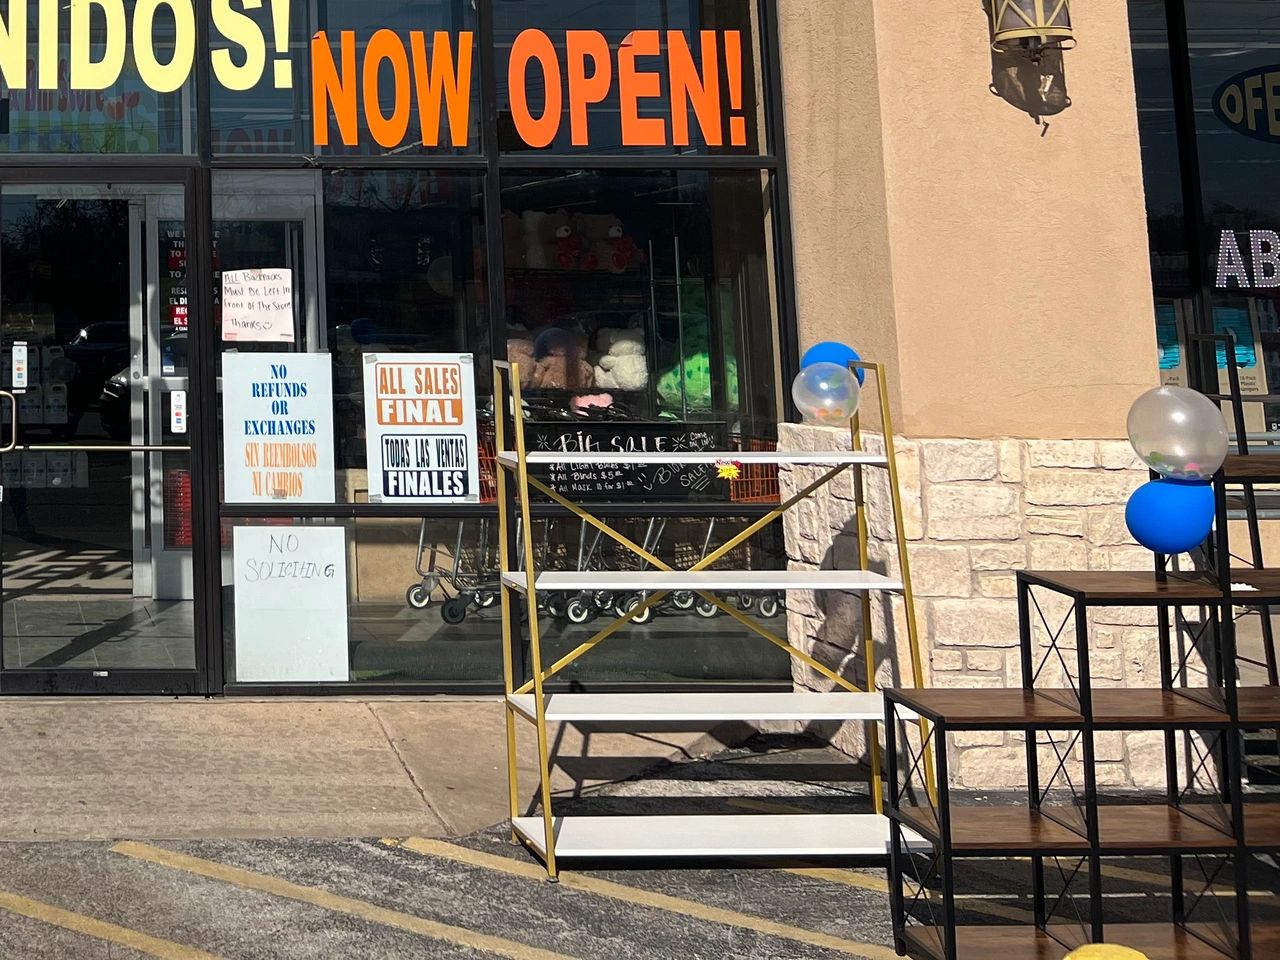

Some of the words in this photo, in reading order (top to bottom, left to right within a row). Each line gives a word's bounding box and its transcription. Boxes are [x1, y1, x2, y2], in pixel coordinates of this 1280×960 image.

[311, 28, 473, 148] NOW
[508, 28, 747, 148] OPEN!
[271, 364, 287, 379] NO
[380, 368, 405, 394] ALL
[415, 368, 458, 394] SALES
[252, 383, 307, 397] REFUNDS
[272, 400, 288, 415] OR
[382, 400, 458, 422] FINAL
[244, 420, 316, 435] EXCHANGES
[245, 443, 260, 468] SIN
[263, 443, 317, 468] REEMBOLSOS
[385, 439, 410, 468] TODAS
[415, 439, 430, 468] LAS
[436, 439, 464, 468] VENTAS
[252, 472, 261, 496] NI
[265, 472, 303, 496] CAMBIOS
[388, 471, 464, 496] FINALES
[270, 534, 299, 553] NO
